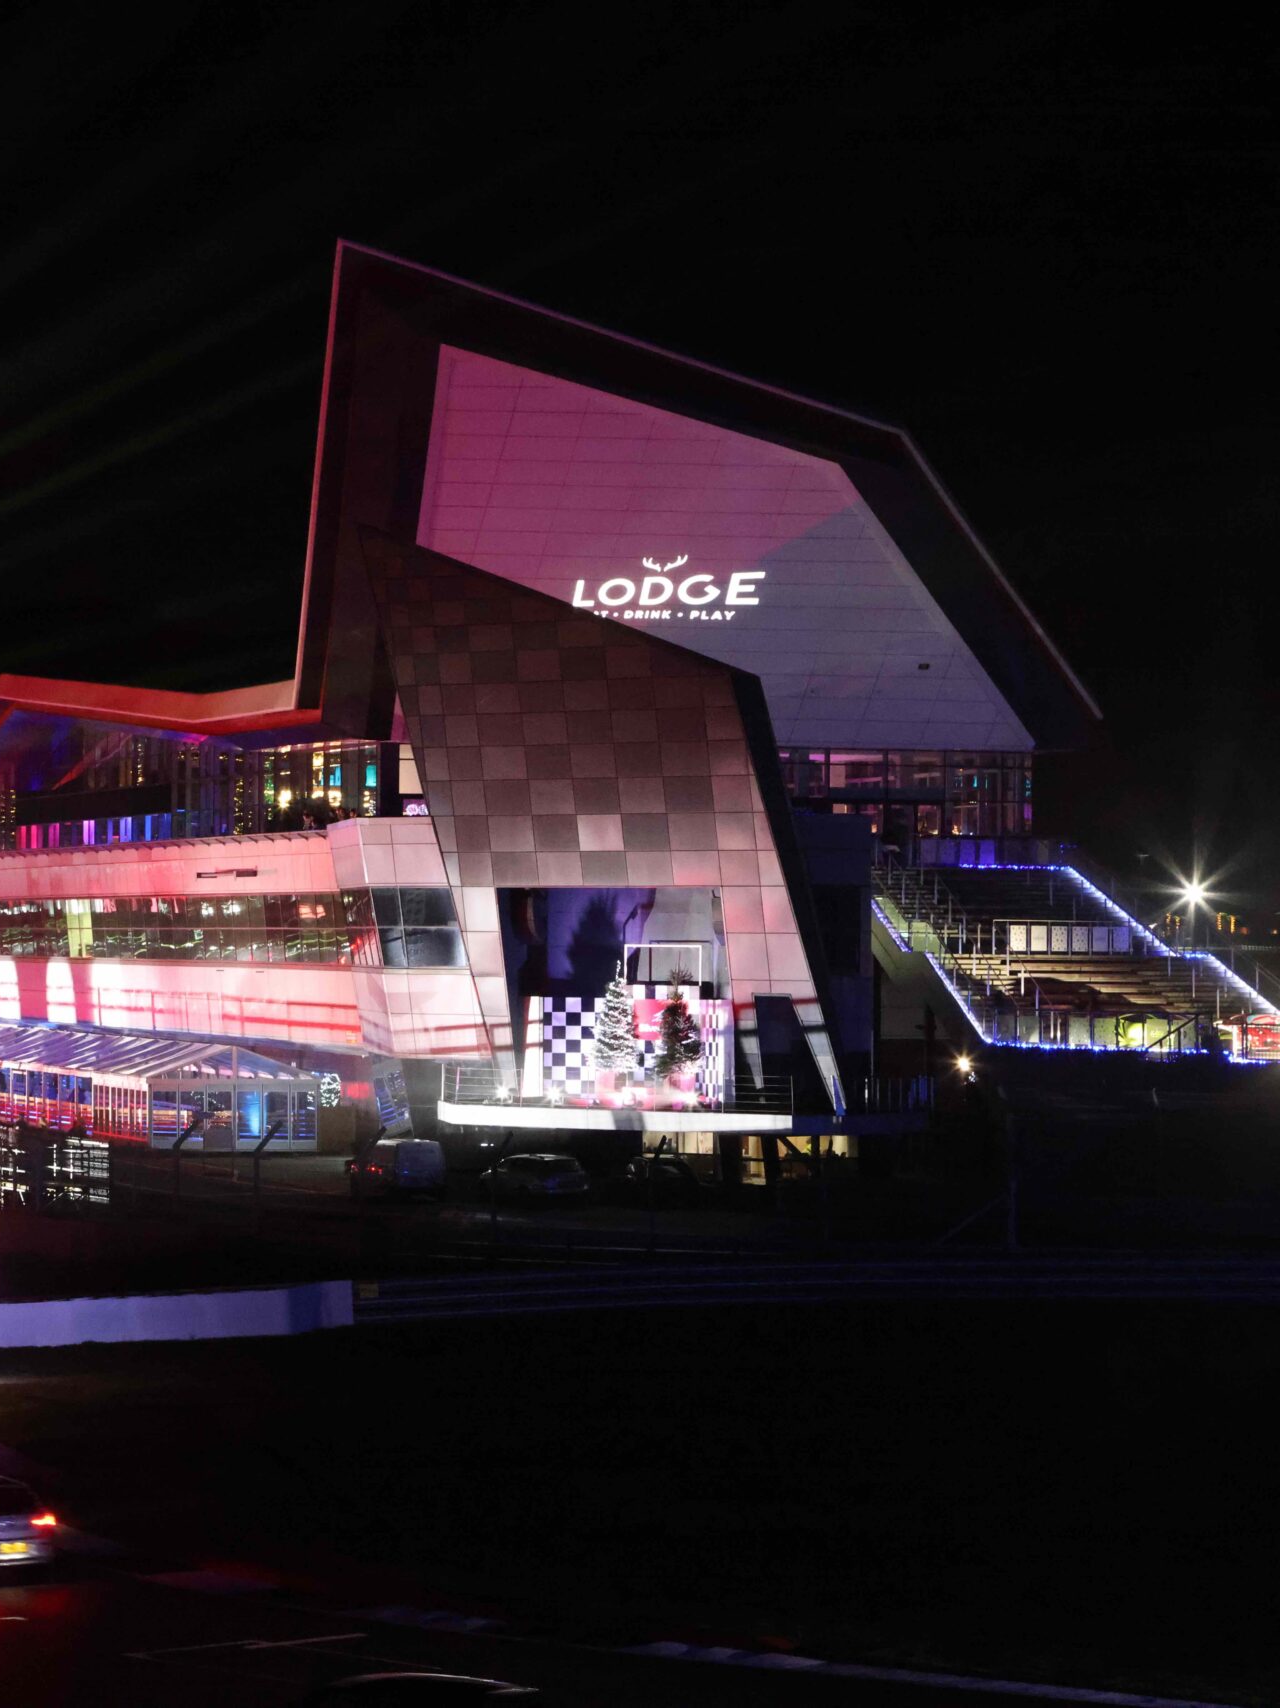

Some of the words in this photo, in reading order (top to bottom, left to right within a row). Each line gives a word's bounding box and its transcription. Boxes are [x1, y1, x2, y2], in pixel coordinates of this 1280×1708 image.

[572, 571, 766, 607] LODGE
[623, 610, 672, 620] DRINK
[689, 610, 736, 621] PLAY
